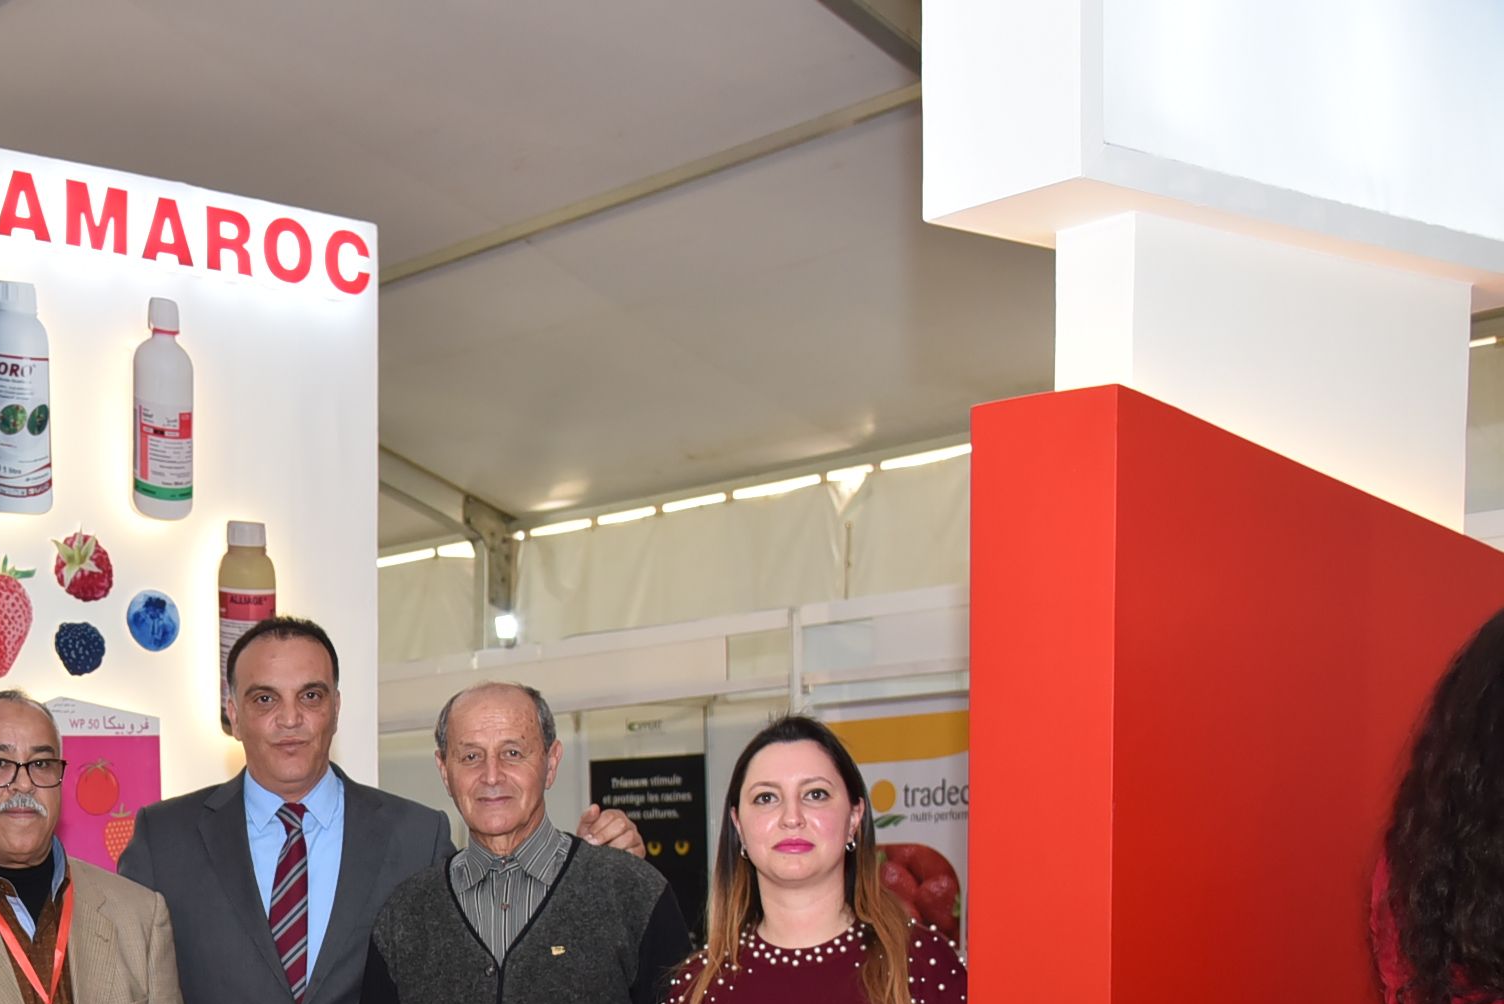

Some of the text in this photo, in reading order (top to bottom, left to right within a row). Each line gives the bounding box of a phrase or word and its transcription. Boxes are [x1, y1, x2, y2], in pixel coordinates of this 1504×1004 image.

[68, 718, 85, 729] WP
[88, 718, 100, 730] 50
[650, 774, 682, 786] stimule
[602, 795, 611, 805] et
[660, 791, 693, 803] racines
